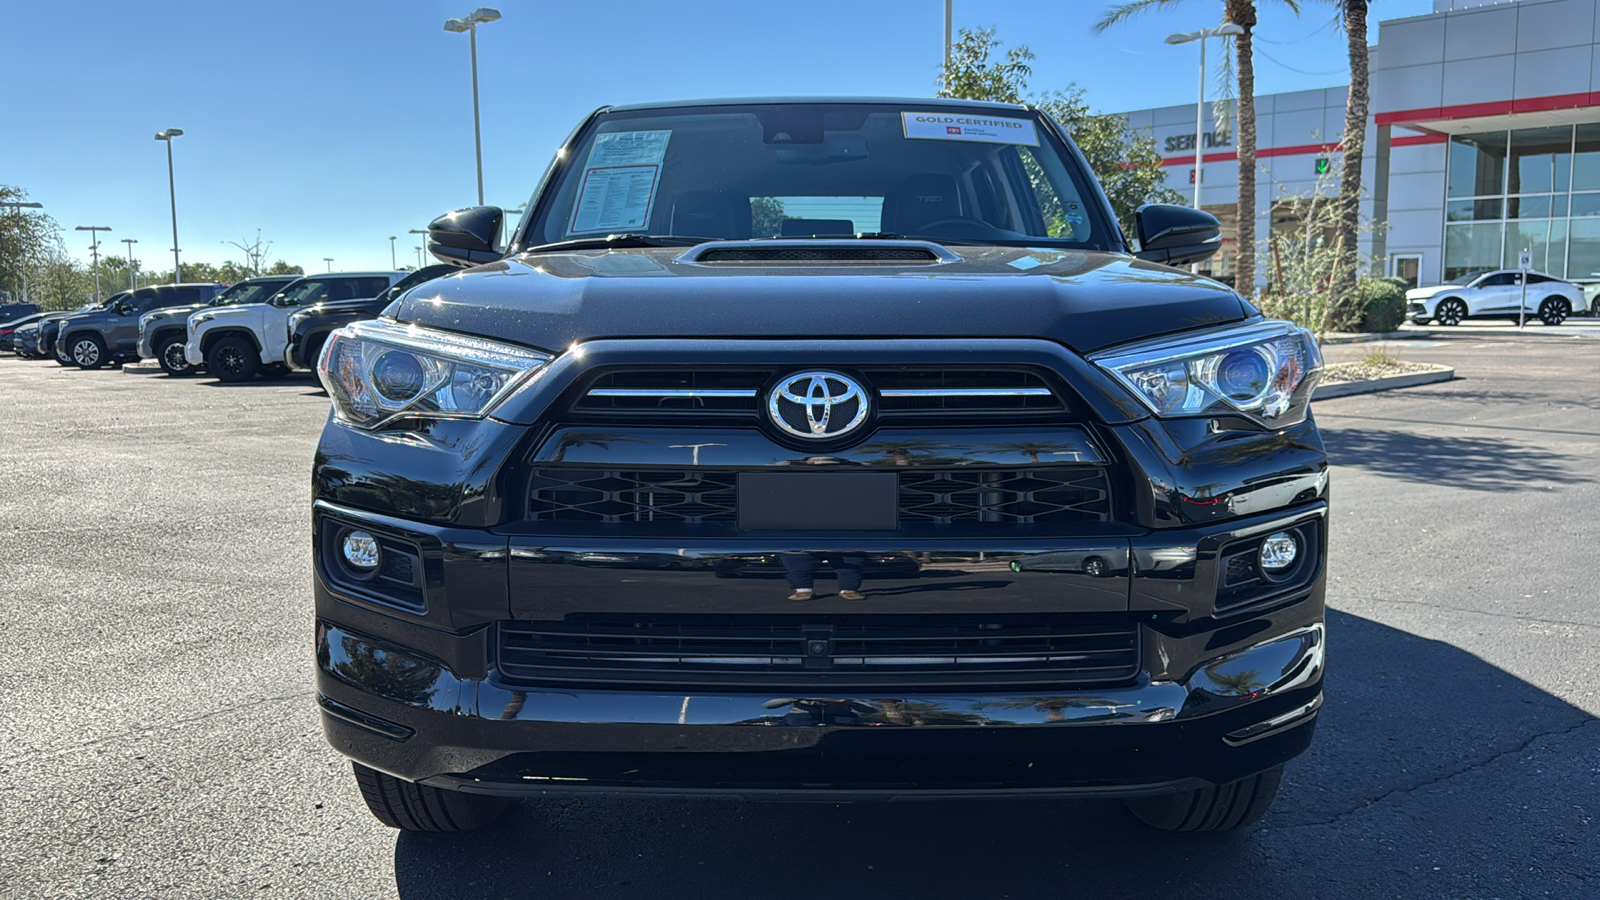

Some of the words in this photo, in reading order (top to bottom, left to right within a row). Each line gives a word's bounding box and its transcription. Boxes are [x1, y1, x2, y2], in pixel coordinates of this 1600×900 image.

[915, 116, 954, 124] GOLD
[956, 117, 1023, 129] CERTIFIED
[913, 195, 943, 203] TRD
